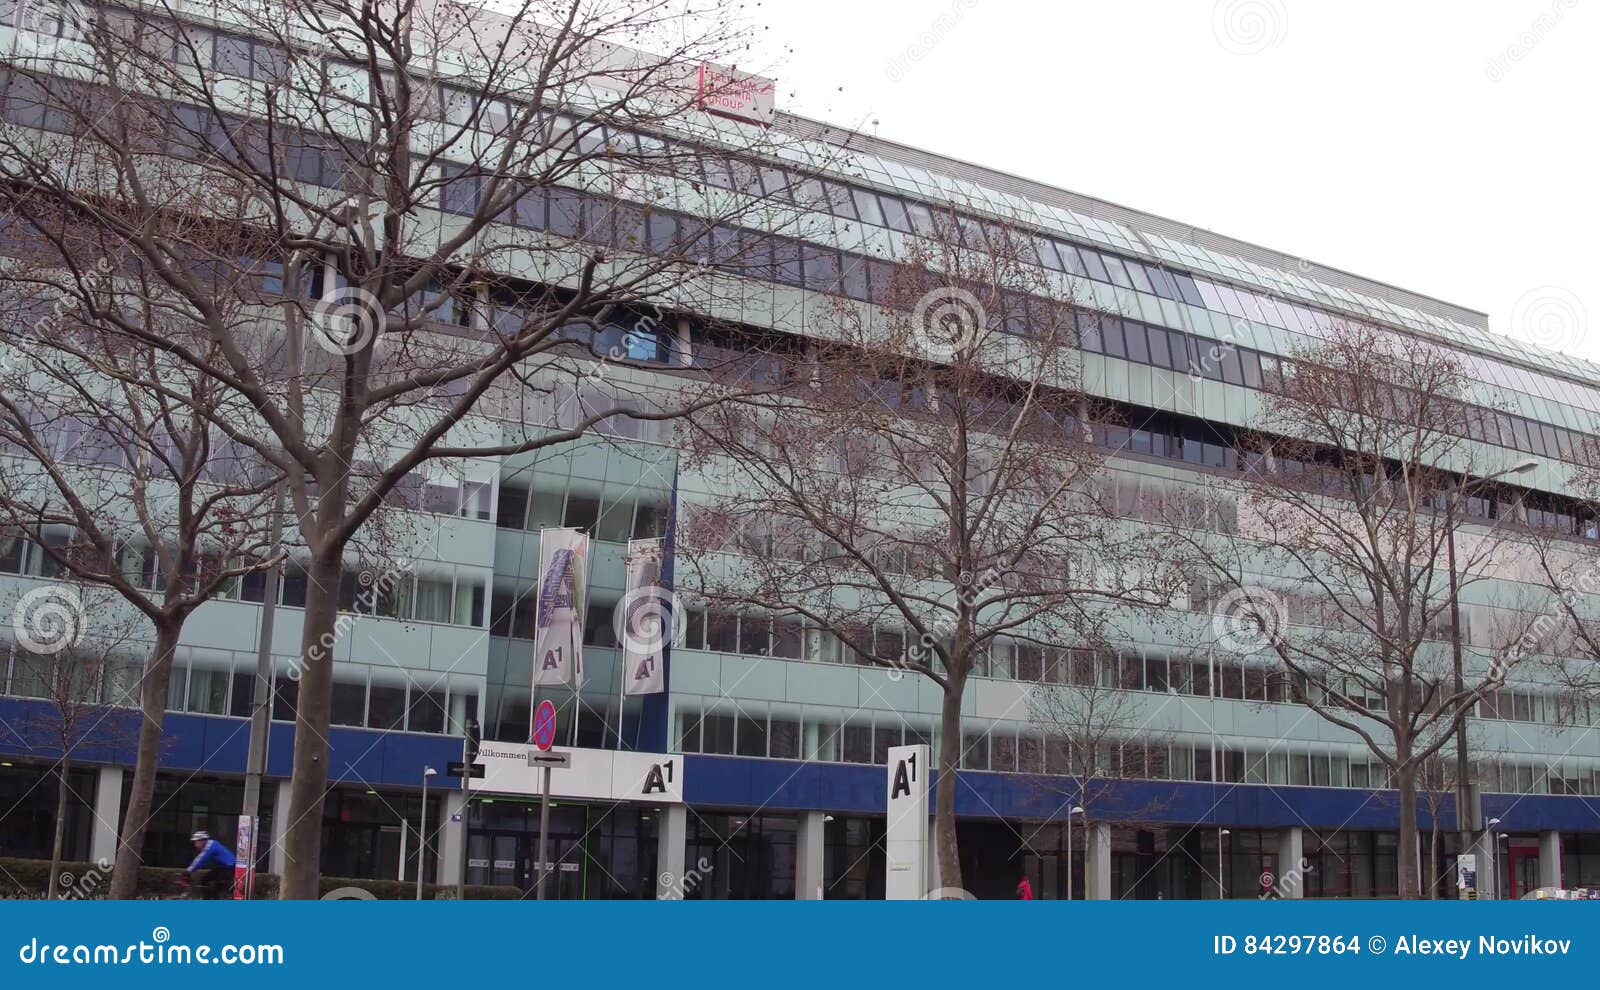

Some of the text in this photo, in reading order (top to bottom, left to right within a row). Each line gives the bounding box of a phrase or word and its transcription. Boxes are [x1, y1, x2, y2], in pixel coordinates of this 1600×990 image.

[542, 647, 562, 670] A1
[634, 656, 654, 680] A1
[641, 759, 673, 794] A1
[891, 752, 916, 800] A1
